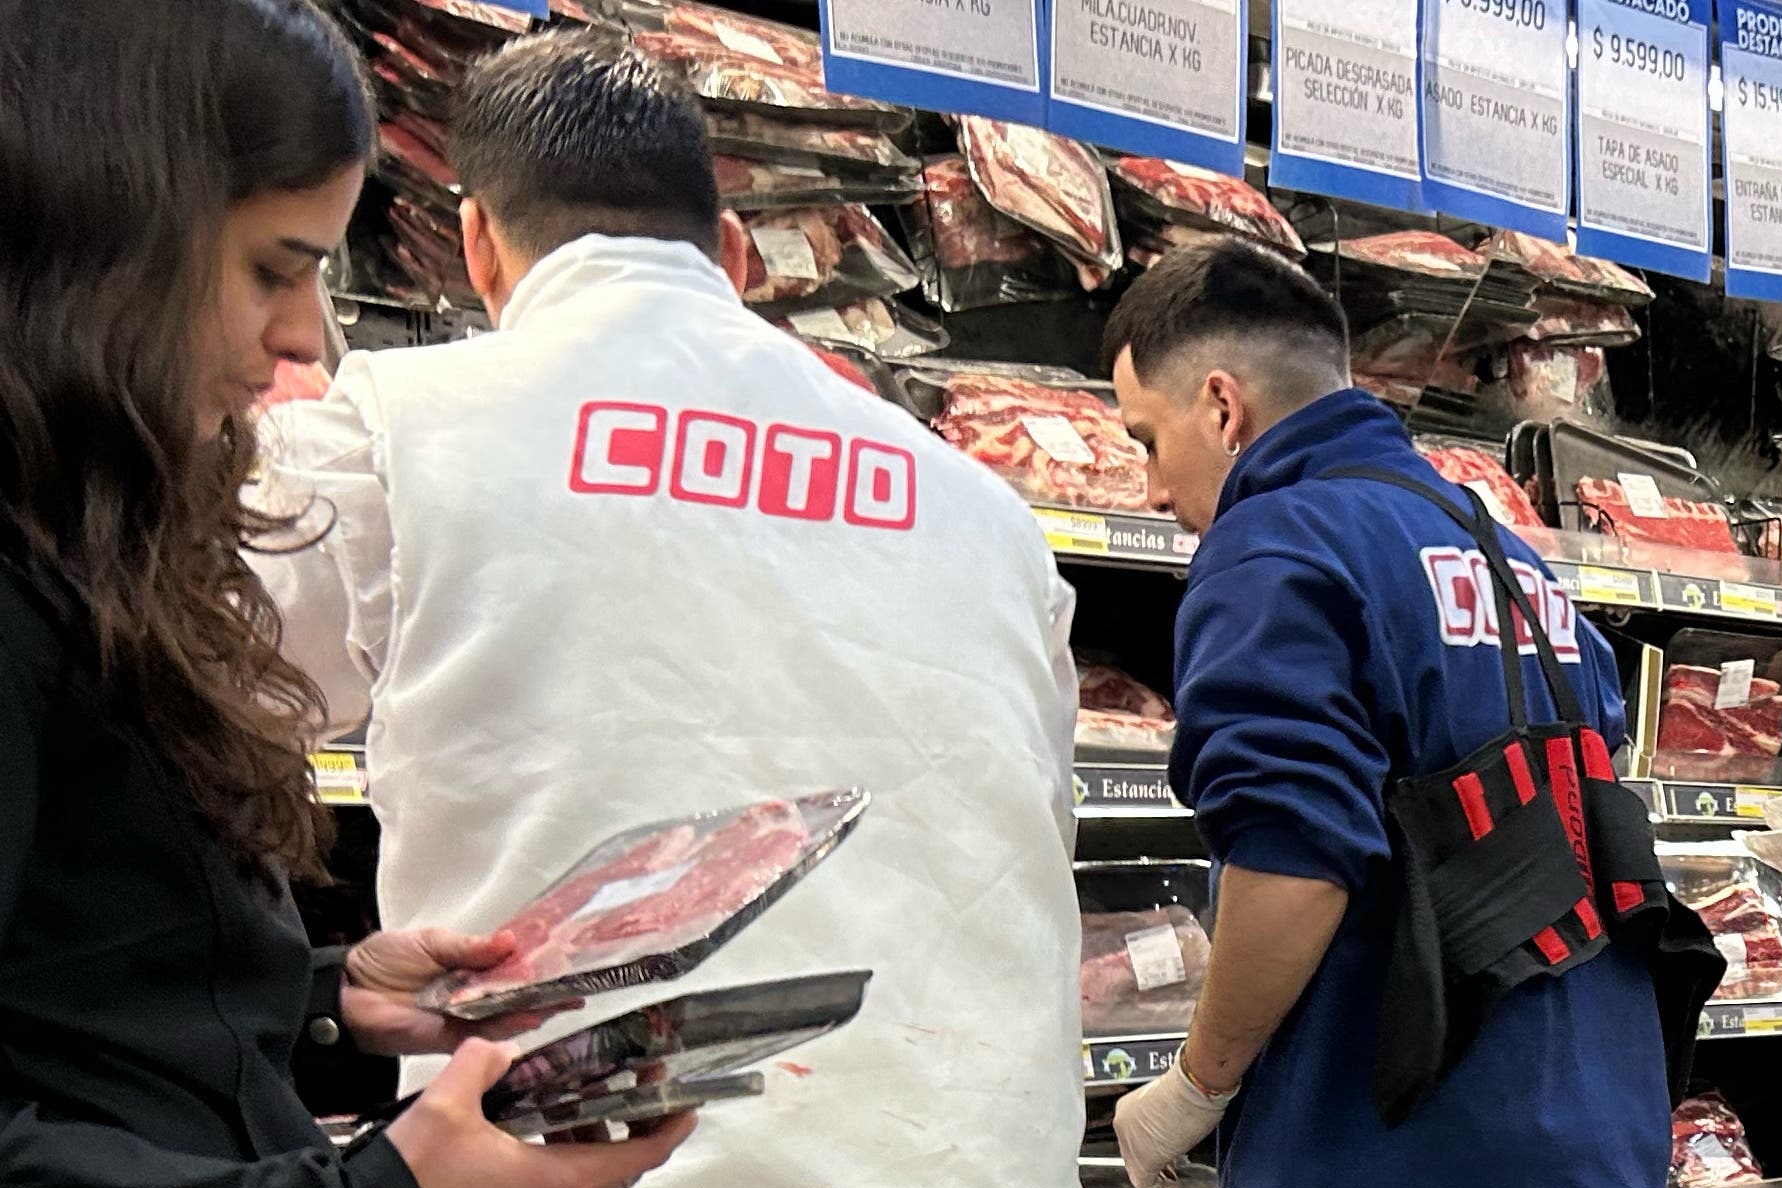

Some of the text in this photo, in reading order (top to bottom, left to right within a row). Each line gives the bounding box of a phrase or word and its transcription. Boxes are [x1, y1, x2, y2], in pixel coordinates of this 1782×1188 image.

[1090, 21, 1202, 72] ESTANCIA X KG
[1593, 26, 1685, 82] $ 9.599,00
[1286, 47, 1414, 97] PICADA DESGRASADA
[1738, 75, 1748, 107] $
[1304, 78, 1404, 120] SELECCIÓN X KG
[1425, 81, 1558, 136] ASADO ESTANCIA X KG
[1599, 135, 1679, 174] TAPA DE ASADO
[1602, 162, 1679, 196] ESPECIAL X KG
[570, 401, 916, 530] COTO
[1105, 527, 1166, 550] tancias
[1102, 778, 1175, 801] Estancia
